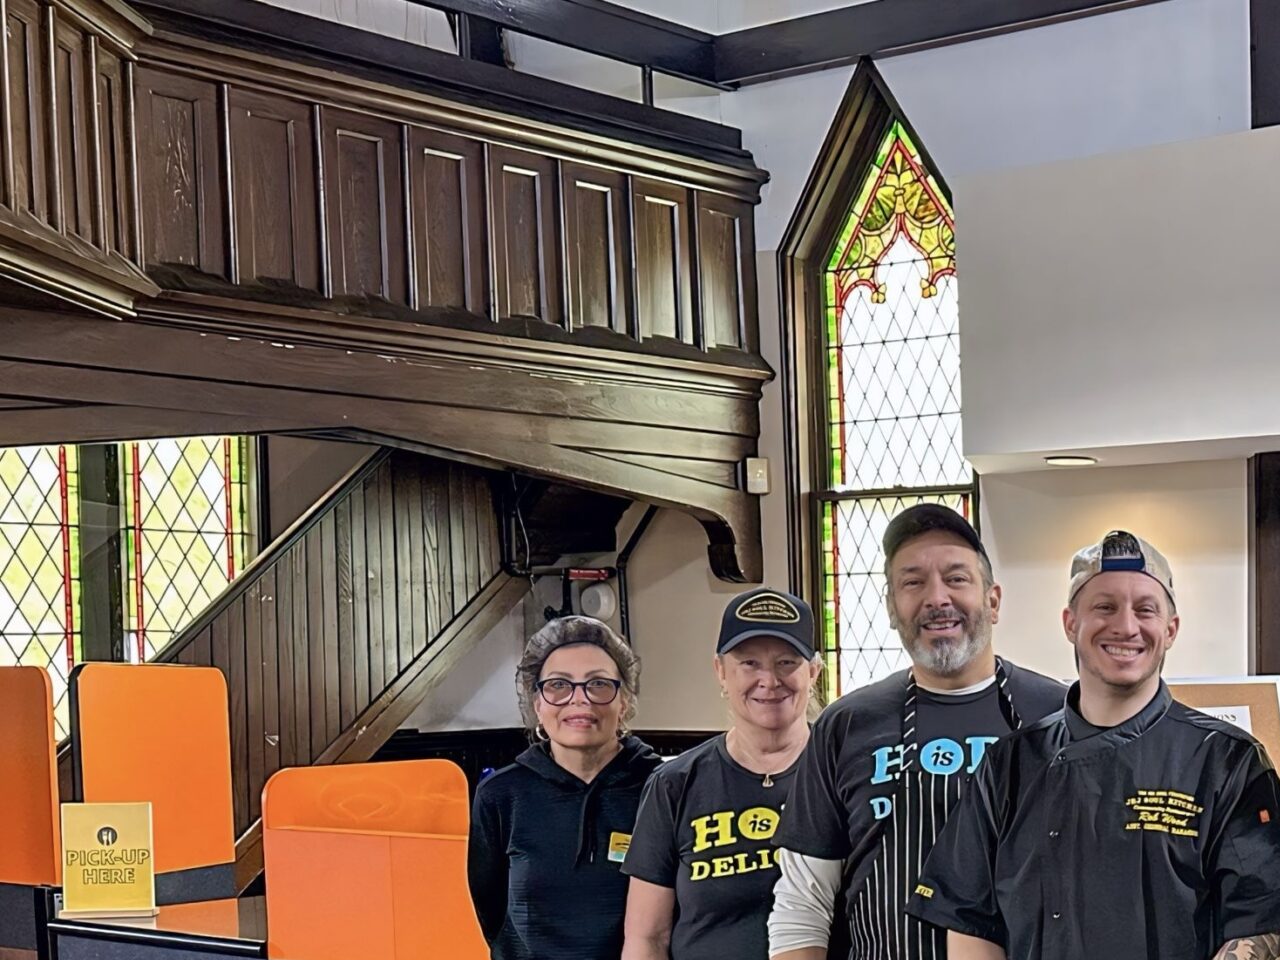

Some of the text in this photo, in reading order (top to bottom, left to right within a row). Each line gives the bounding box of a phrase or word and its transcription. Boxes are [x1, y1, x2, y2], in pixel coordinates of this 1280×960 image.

[931, 745, 955, 766] is
[749, 813, 771, 833] is
[66, 848, 151, 867] PICK-UP
[82, 867, 136, 885] HERE
